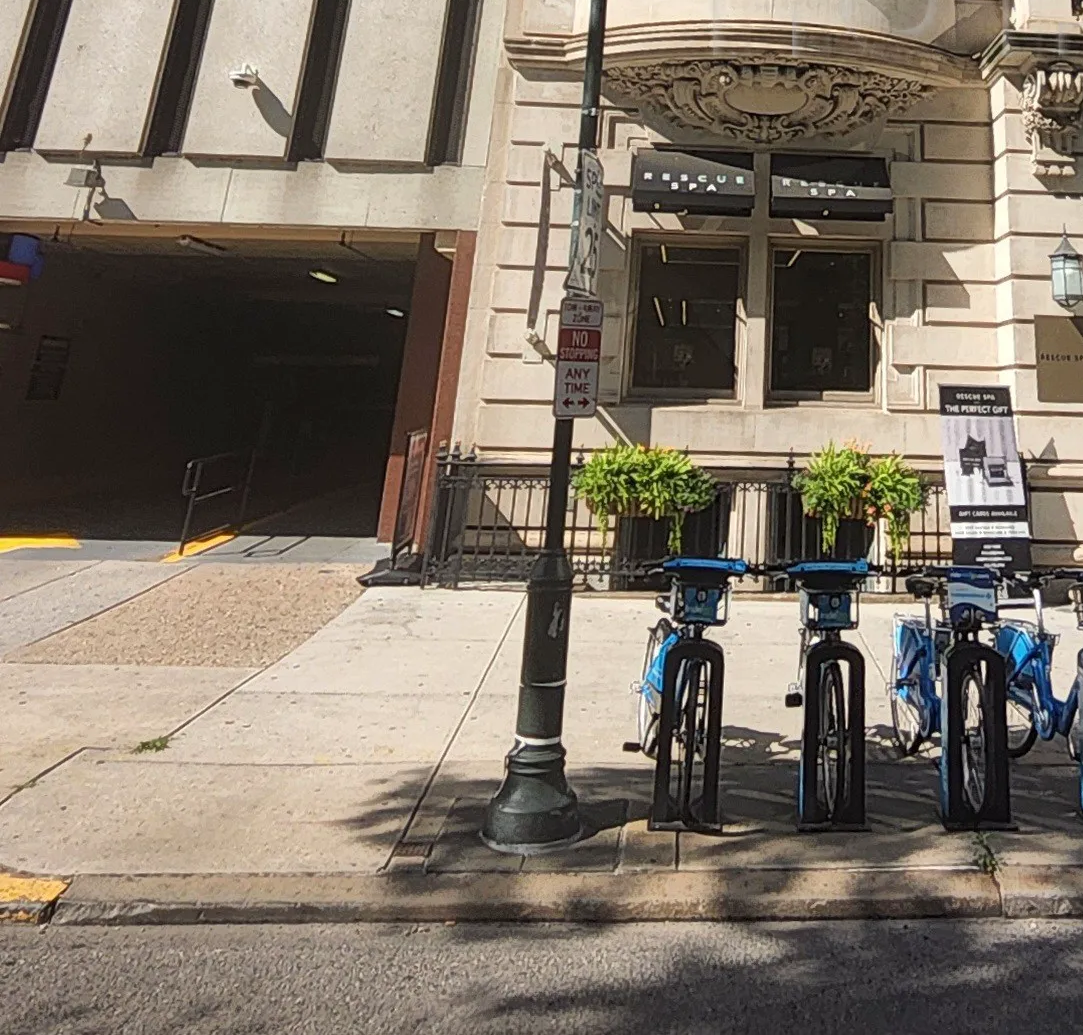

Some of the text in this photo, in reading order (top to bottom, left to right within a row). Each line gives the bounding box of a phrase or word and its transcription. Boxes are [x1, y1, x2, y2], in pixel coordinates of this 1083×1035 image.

[644, 172, 745, 185] RESCUE
[670, 181, 717, 193] SPA
[810, 187, 856, 197] SPA
[572, 330, 589, 347] NO
[560, 347, 599, 360] STOPPING
[1040, 352, 1071, 362] RESCUE
[564, 368, 591, 380] ANY
[564, 382, 591, 394] TIME
[955, 392, 996, 401] RESCUE SPA
[944, 404, 1009, 414] THE PERFECT GIFT
